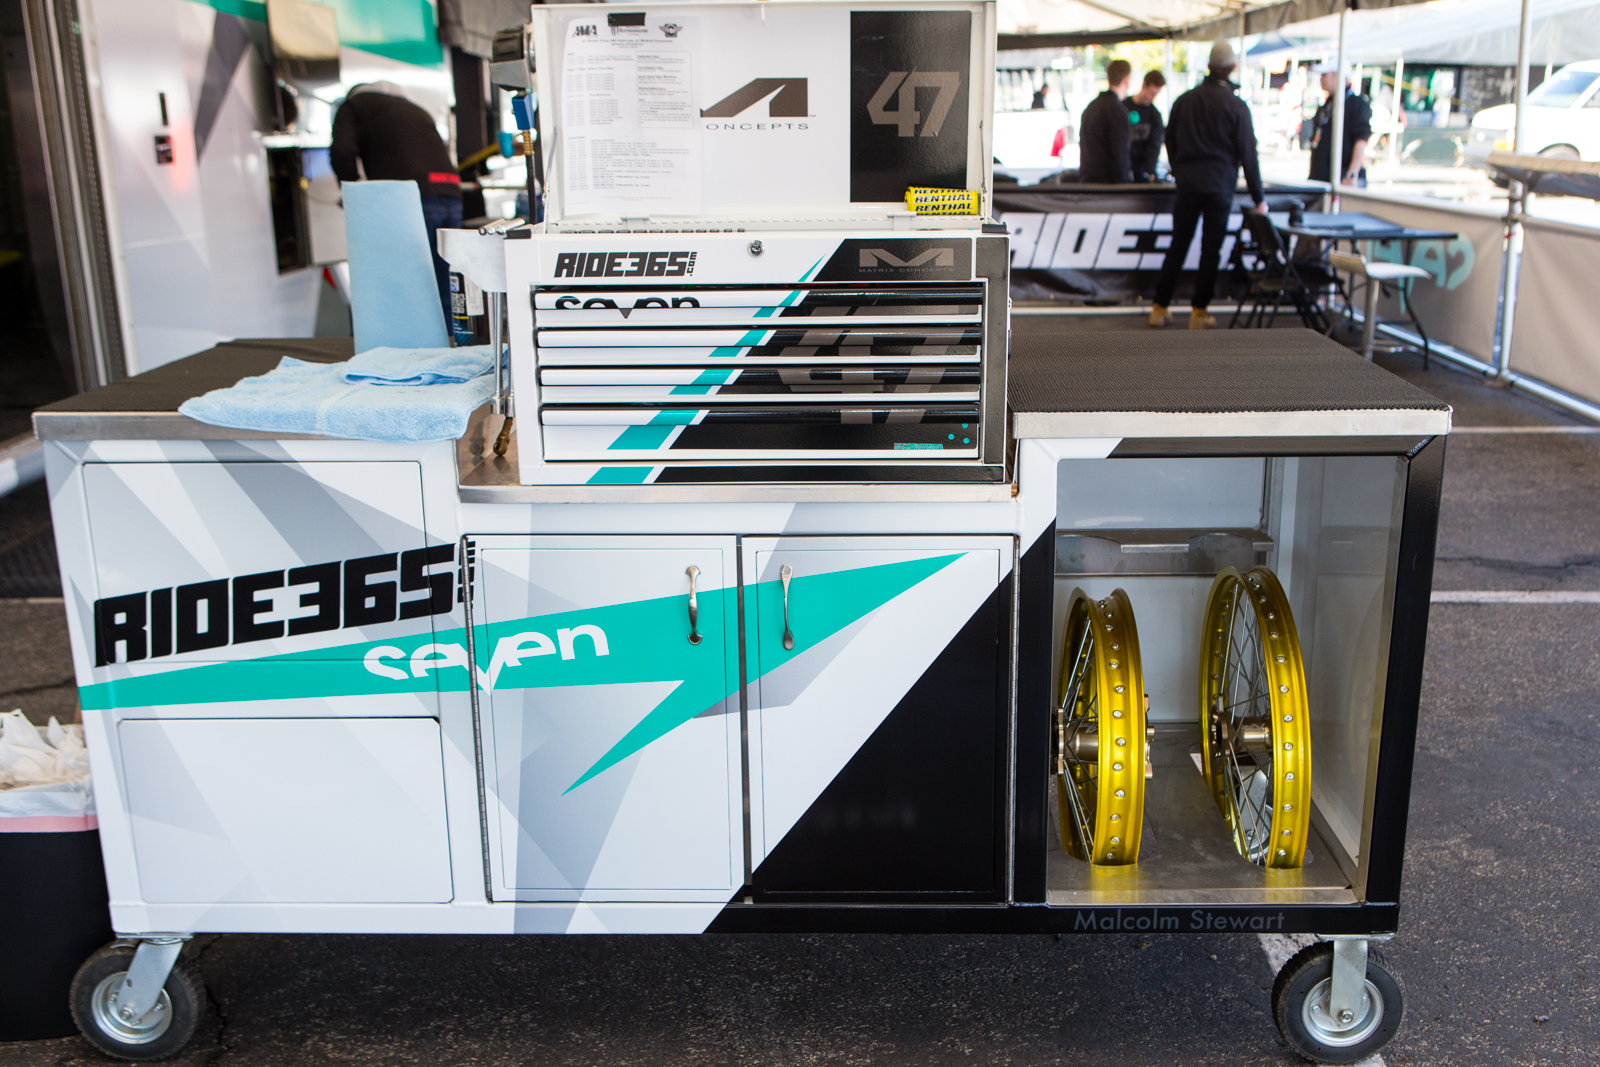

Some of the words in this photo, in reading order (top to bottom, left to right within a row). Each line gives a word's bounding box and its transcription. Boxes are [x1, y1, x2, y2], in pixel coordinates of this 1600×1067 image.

[866, 66, 962, 137] 47
[914, 194, 974, 204] RENTHAL
[915, 202, 974, 212] RENTHAL
[553, 252, 690, 278] RIDE365
[94, 542, 457, 668] RIDE365
[363, 623, 610, 696] seven
[1073, 908, 1180, 931] Malcolm
[1189, 909, 1285, 931] Stewart
